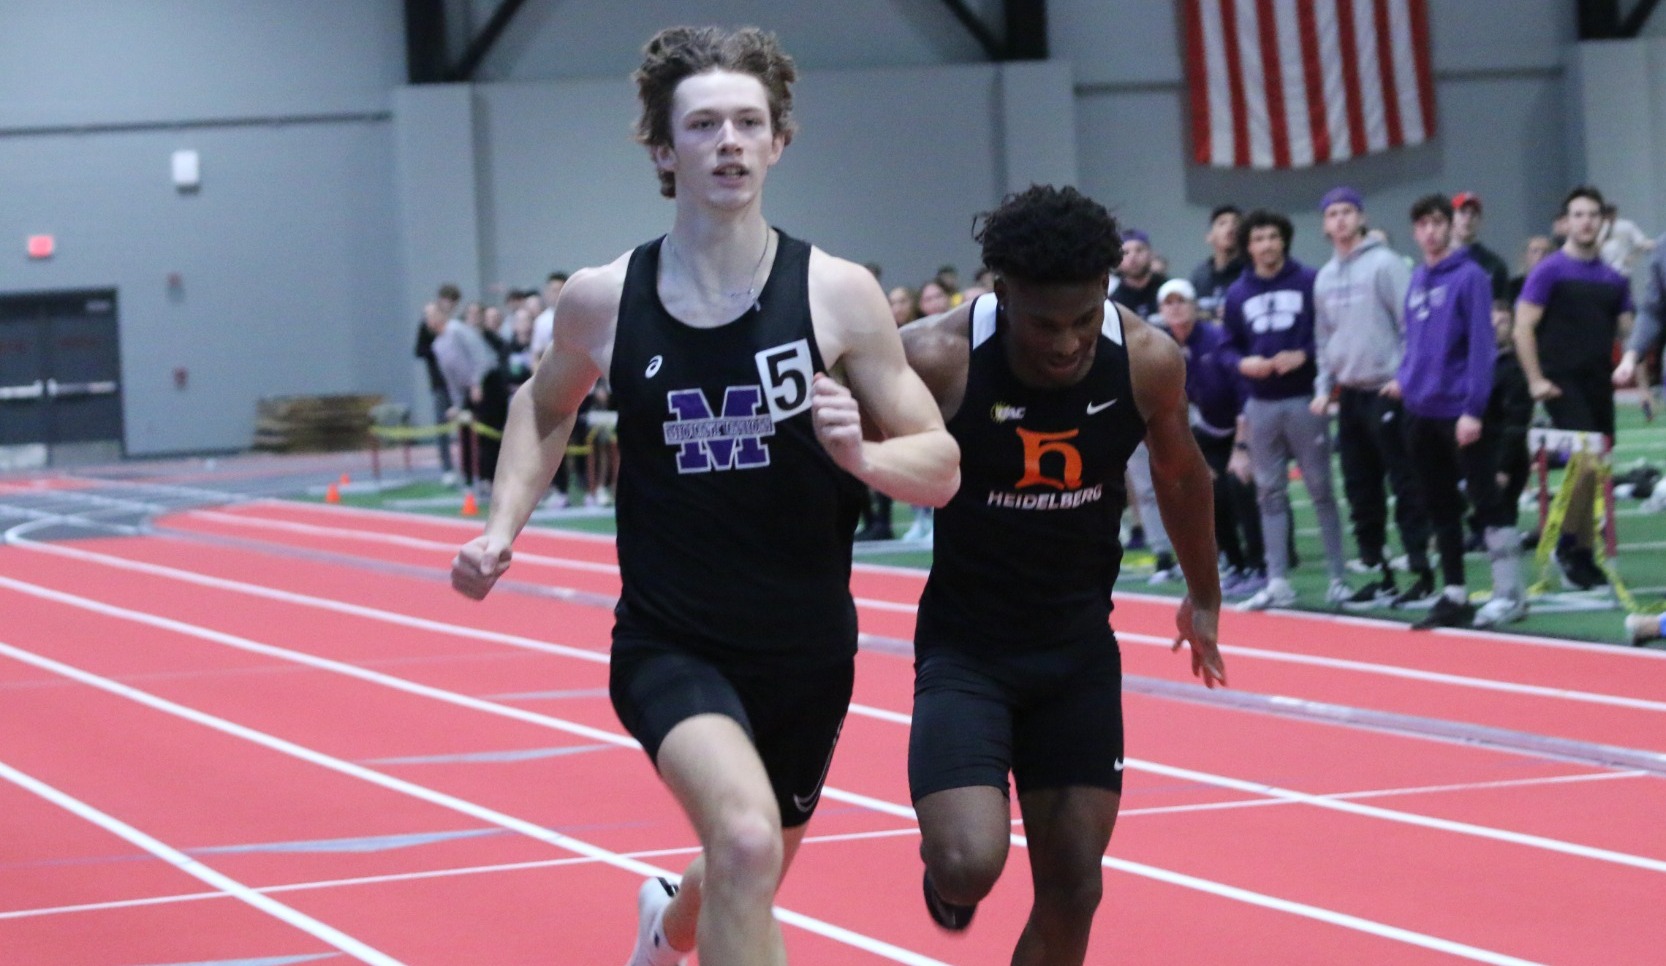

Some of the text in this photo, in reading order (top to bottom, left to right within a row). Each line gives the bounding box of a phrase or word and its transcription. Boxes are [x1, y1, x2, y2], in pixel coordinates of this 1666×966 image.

[766, 348, 807, 411] 5
[667, 385, 770, 474] M
[987, 484, 1103, 510] HEIDELBERG
